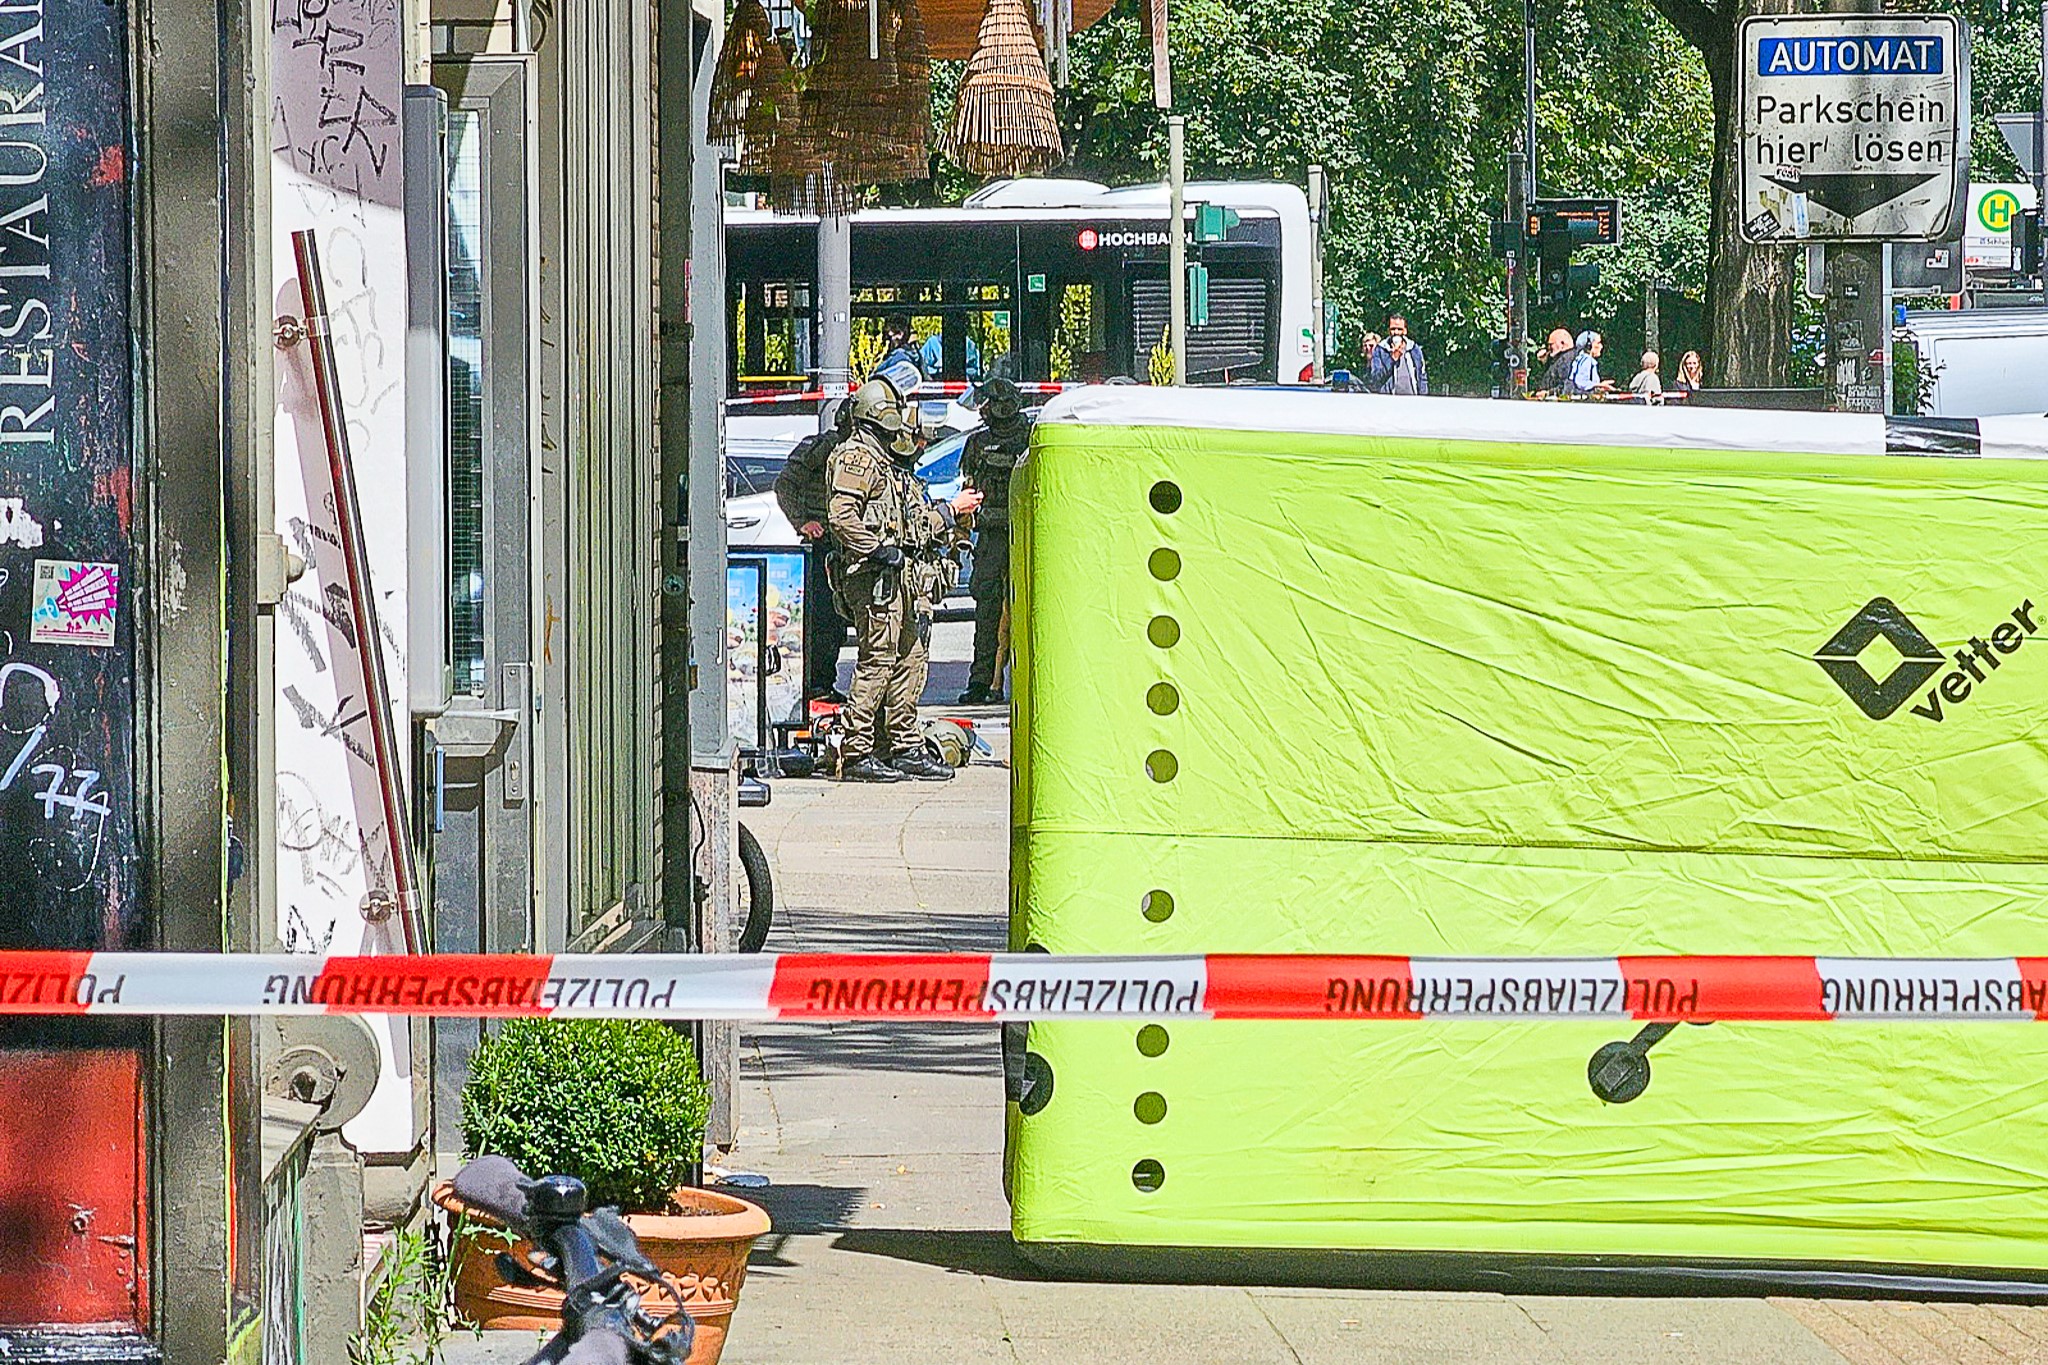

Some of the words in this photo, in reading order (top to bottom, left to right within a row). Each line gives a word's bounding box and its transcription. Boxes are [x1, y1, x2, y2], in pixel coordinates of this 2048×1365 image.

[1768, 40, 1935, 72] AUTOMAT
[1756, 93, 1944, 124] Parkschein
[1756, 134, 1823, 165] hier
[1854, 132, 1943, 163] lösen
[1989, 199, 2010, 222] H
[1099, 231, 1193, 247] HOCHBAN
[1909, 598, 2038, 723] vetter
